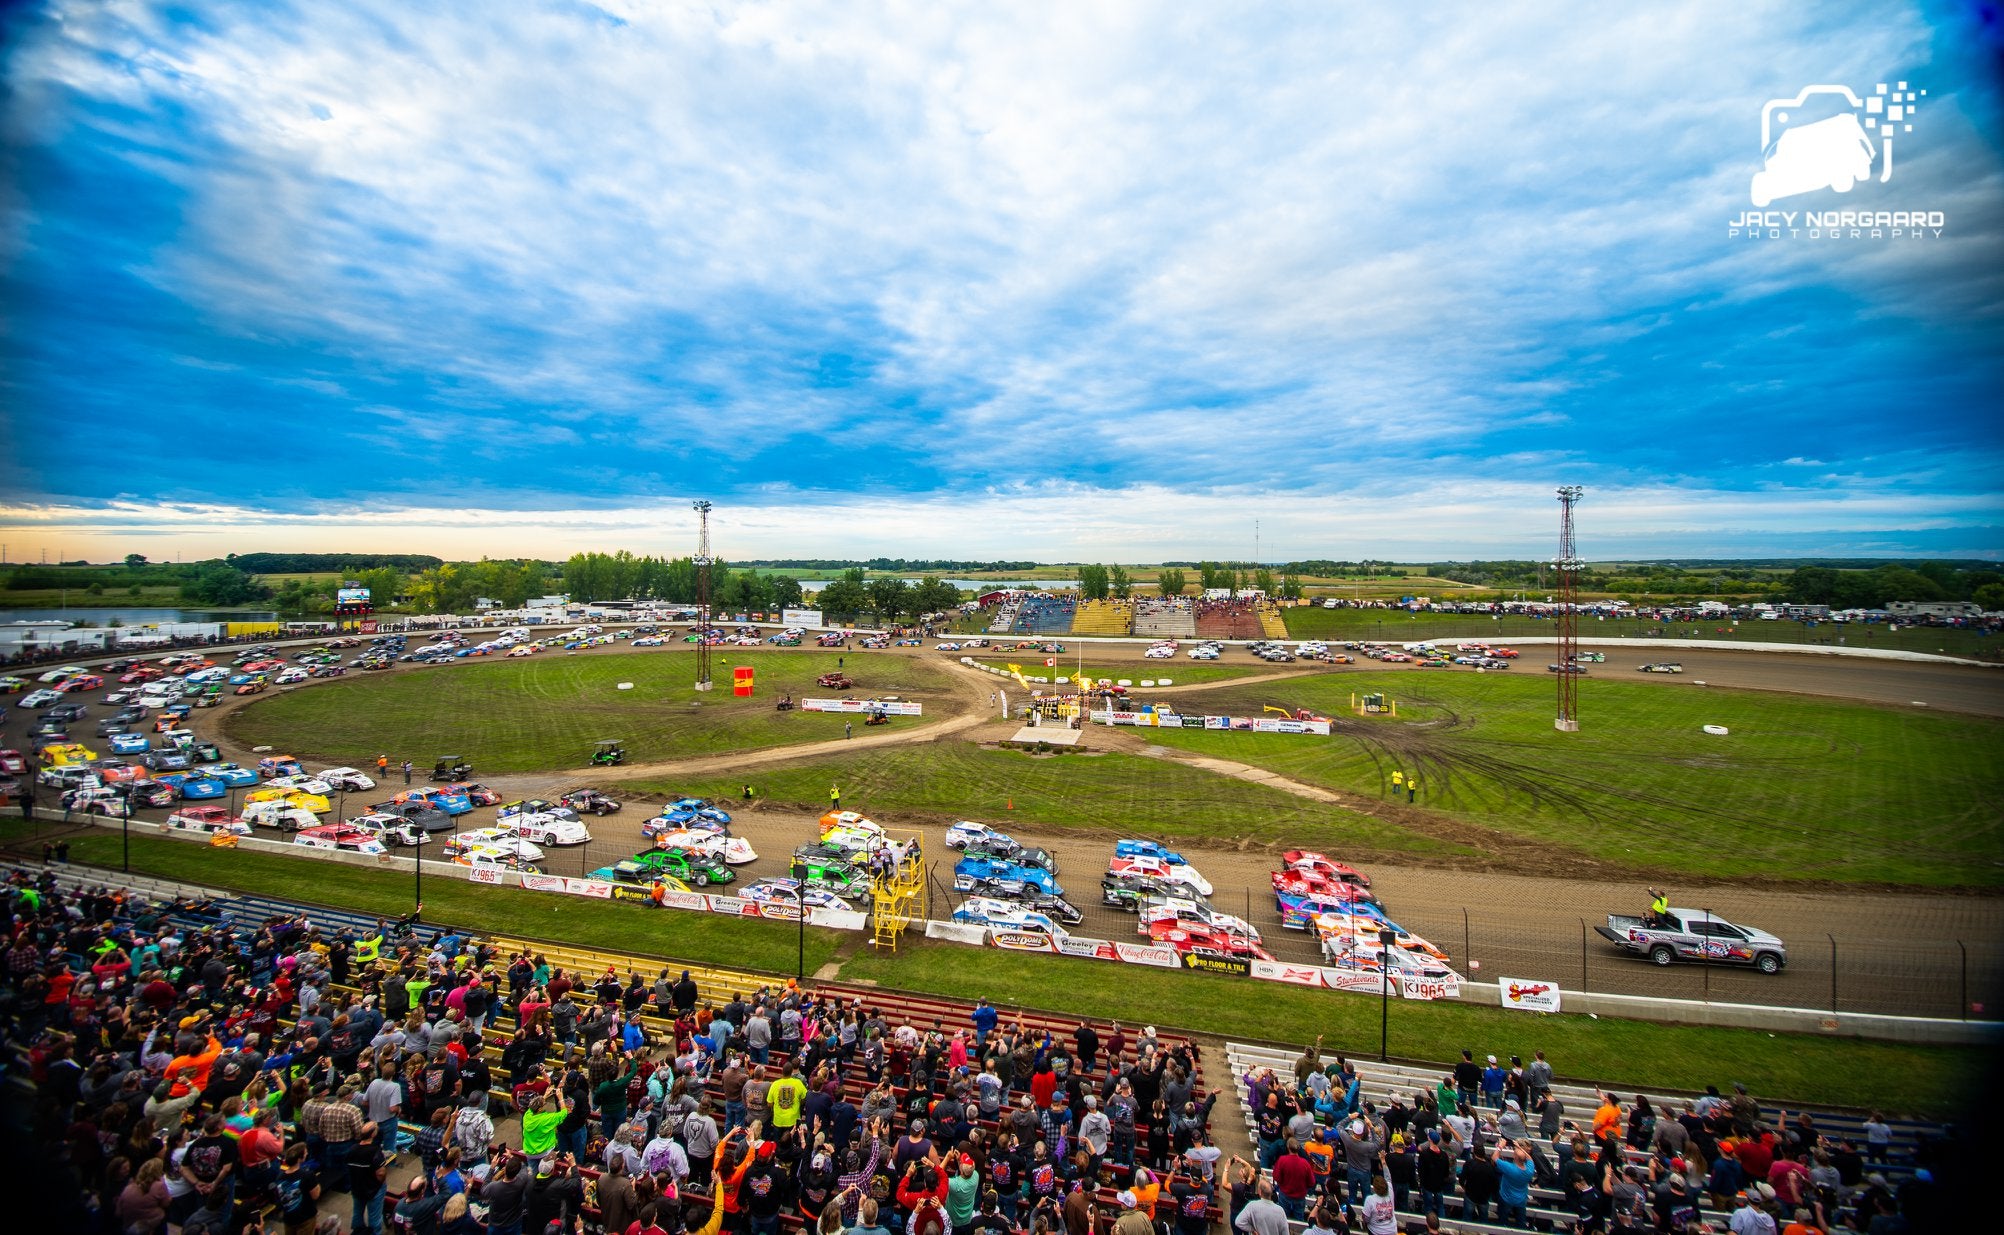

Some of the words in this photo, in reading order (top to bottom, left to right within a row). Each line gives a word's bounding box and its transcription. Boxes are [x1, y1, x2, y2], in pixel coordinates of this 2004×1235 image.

[715, 899, 741, 908] Greeley
[1061, 939, 1094, 950] Greeley
[1118, 944, 1140, 960] Viking
[1196, 959, 1207, 967] PRO
[1208, 961, 1226, 969] FLOOR
[1233, 964, 1245, 972] TILE
